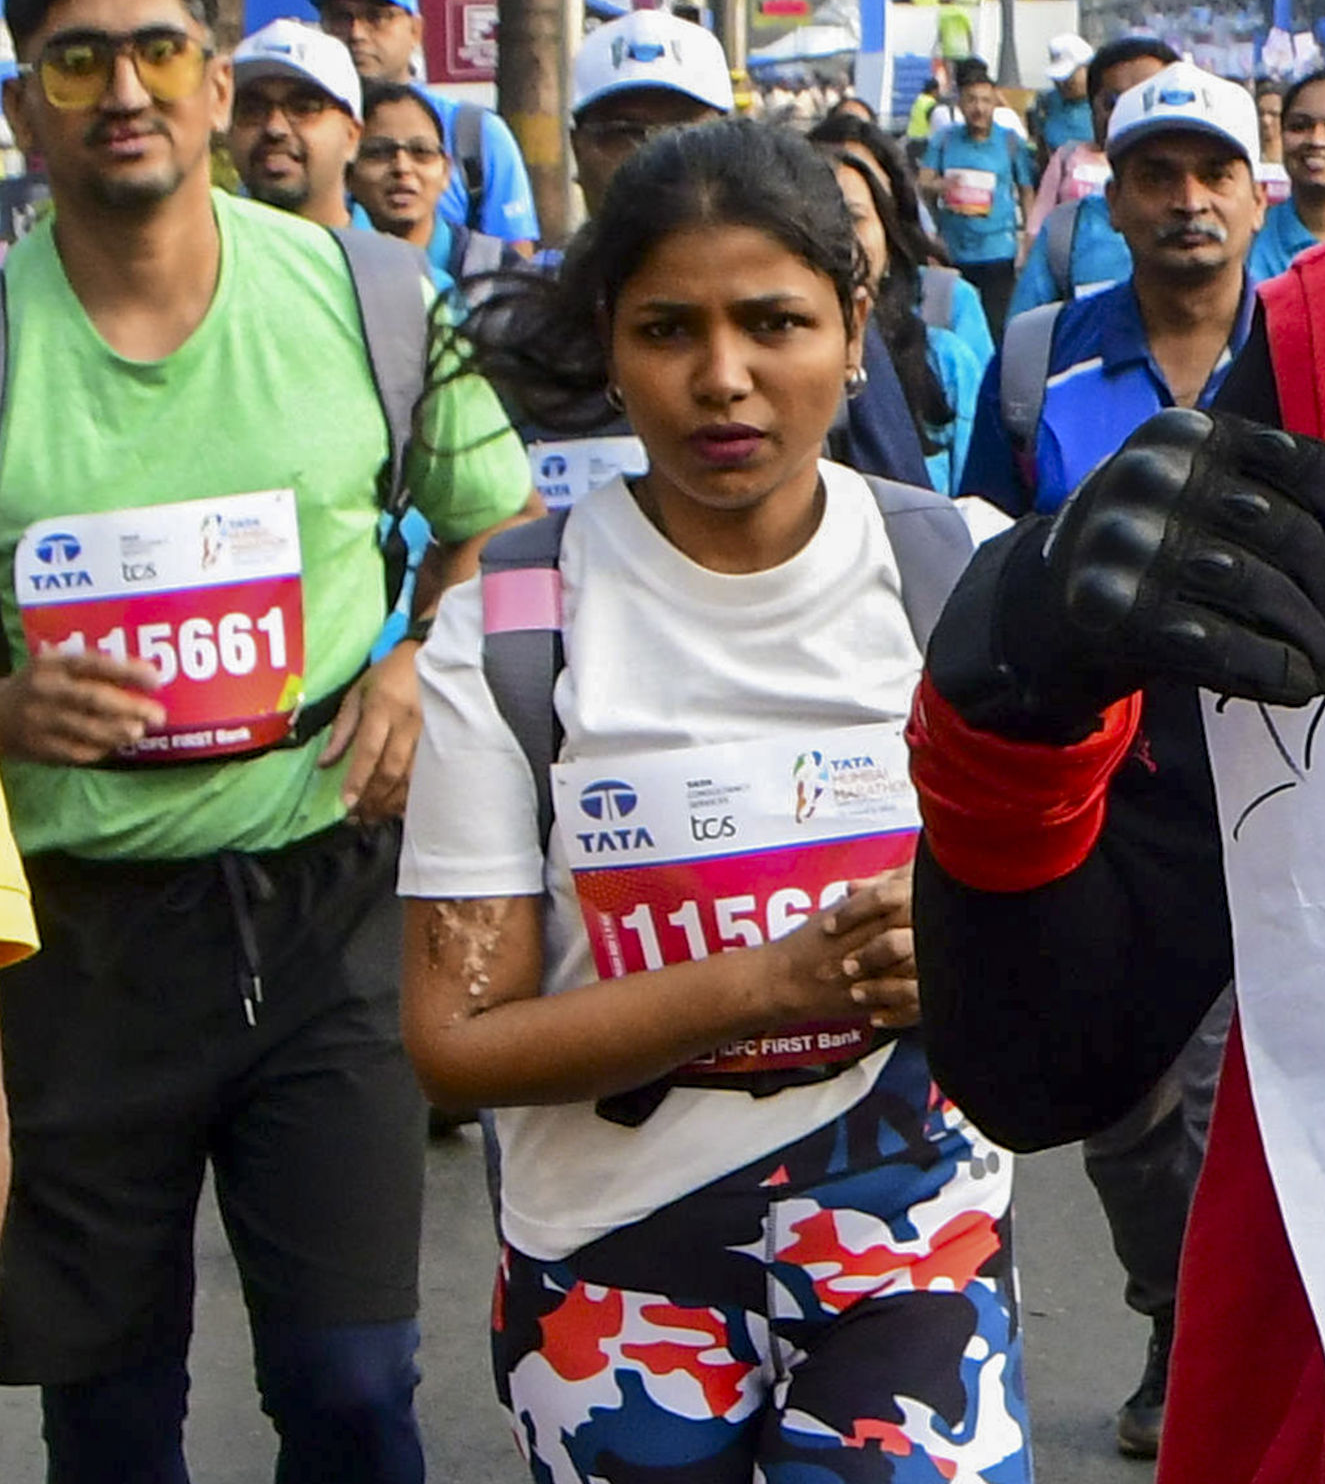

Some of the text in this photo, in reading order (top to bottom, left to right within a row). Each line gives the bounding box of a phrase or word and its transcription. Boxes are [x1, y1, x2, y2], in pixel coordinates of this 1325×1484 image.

[29, 571, 93, 591] TATA
[121, 562, 157, 582] tcs
[831, 756, 875, 771] TATA
[690, 815, 737, 841] tcs
[576, 827, 655, 853] TATA
[761, 1035, 813, 1055] FIRST
[817, 1028, 862, 1049] Bank
